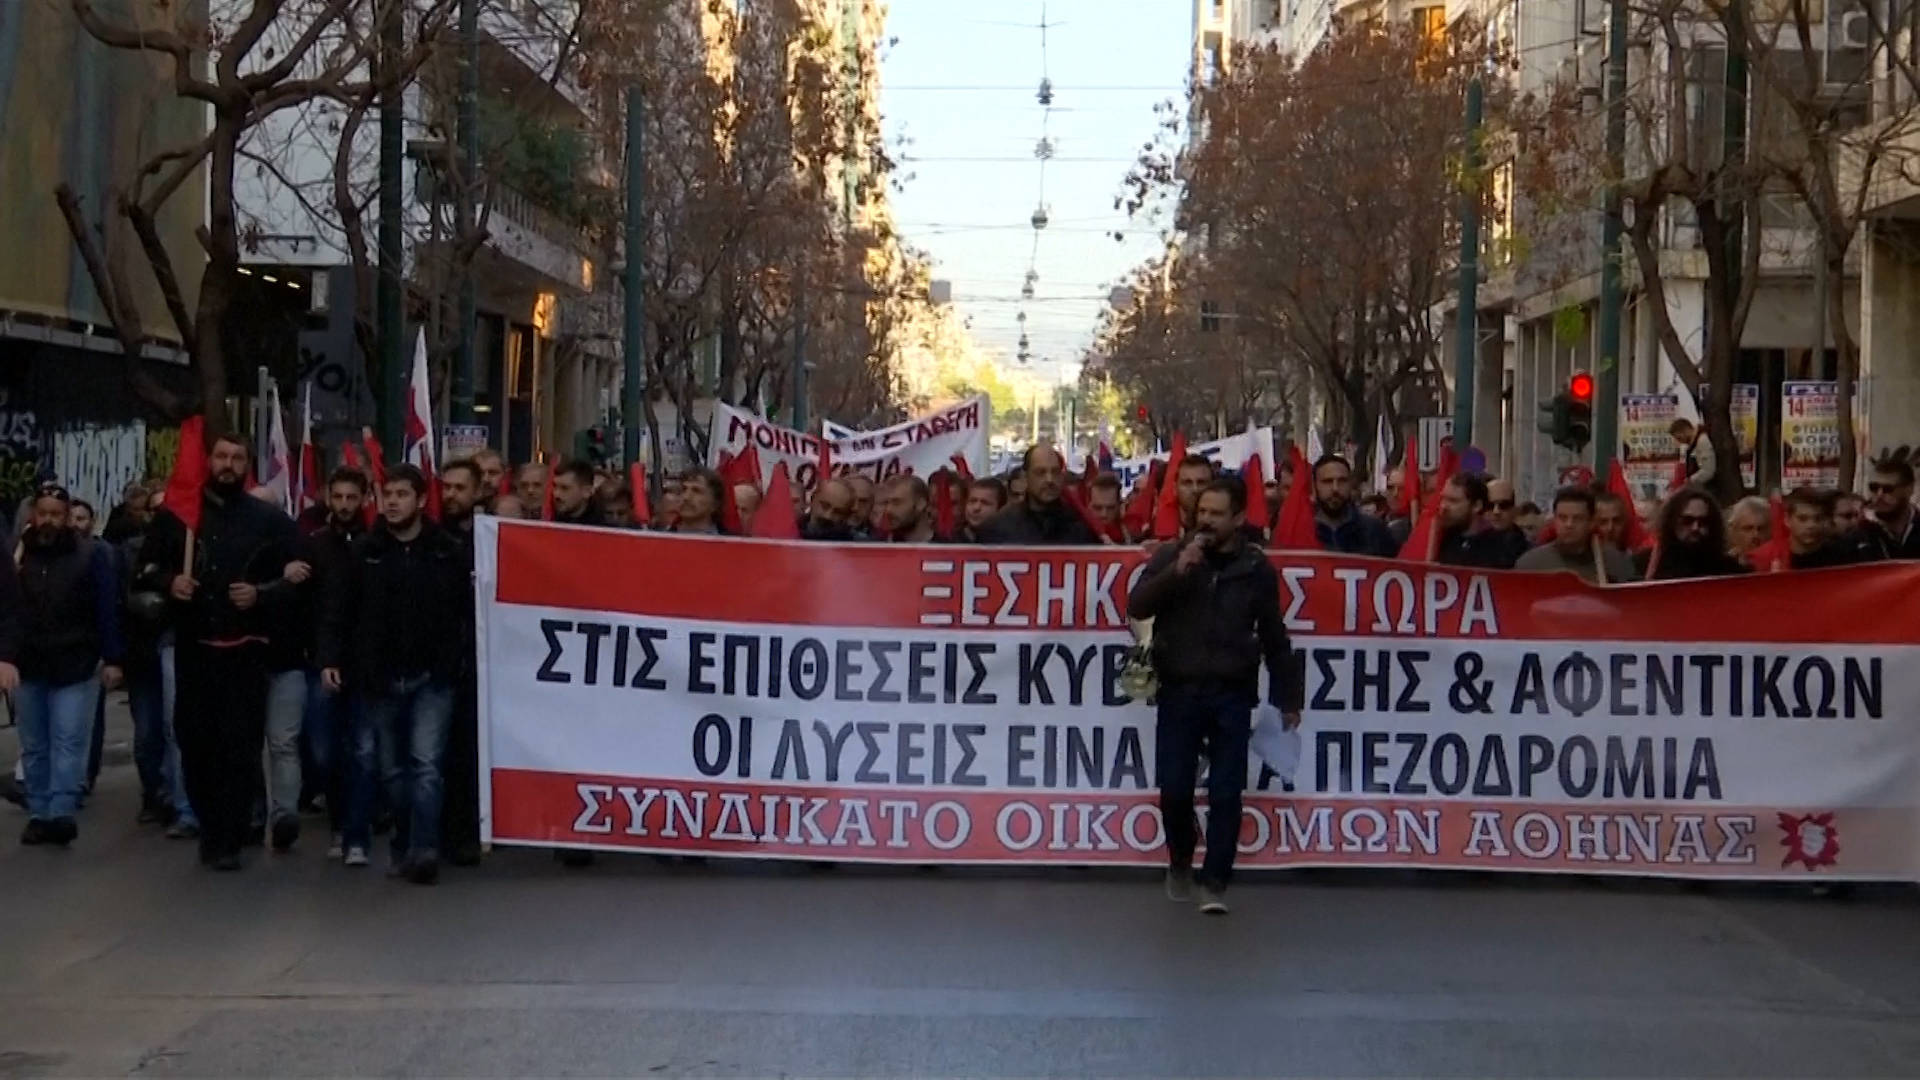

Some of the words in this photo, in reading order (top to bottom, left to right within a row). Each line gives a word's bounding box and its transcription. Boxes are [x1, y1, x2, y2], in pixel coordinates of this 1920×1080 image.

[1788, 398, 1804, 417] 14
[920, 560, 1316, 630] ΞΕΣΗΚΣ
[1334, 569, 1499, 635] ΤΩΡΑ
[536, 618, 668, 691] ΣΤΙΣ
[687, 631, 997, 705] ΕΠΙΘΕΣΕΙΣ
[1018, 642, 1431, 714] ΚΥΒΣΗΣ
[1448, 651, 1493, 715] &
[1510, 652, 1883, 720] ΑΦΕΝΤΙΚΩΝ
[692, 713, 751, 778] ΟΙ
[771, 719, 987, 787] ΛΥΣΕΙΣ
[1007, 725, 1161, 790] ΕΙΝΑ
[1315, 730, 1723, 801] ΠΕΖΟΔΡΟΜΙΑ
[572, 783, 974, 851] ΣΥΝΔΙΚΑΤΟ
[995, 801, 1440, 854] ΟΙΚΟΟΜΩΝ
[1463, 810, 1756, 865] ΑΘΗΝΑΣ
